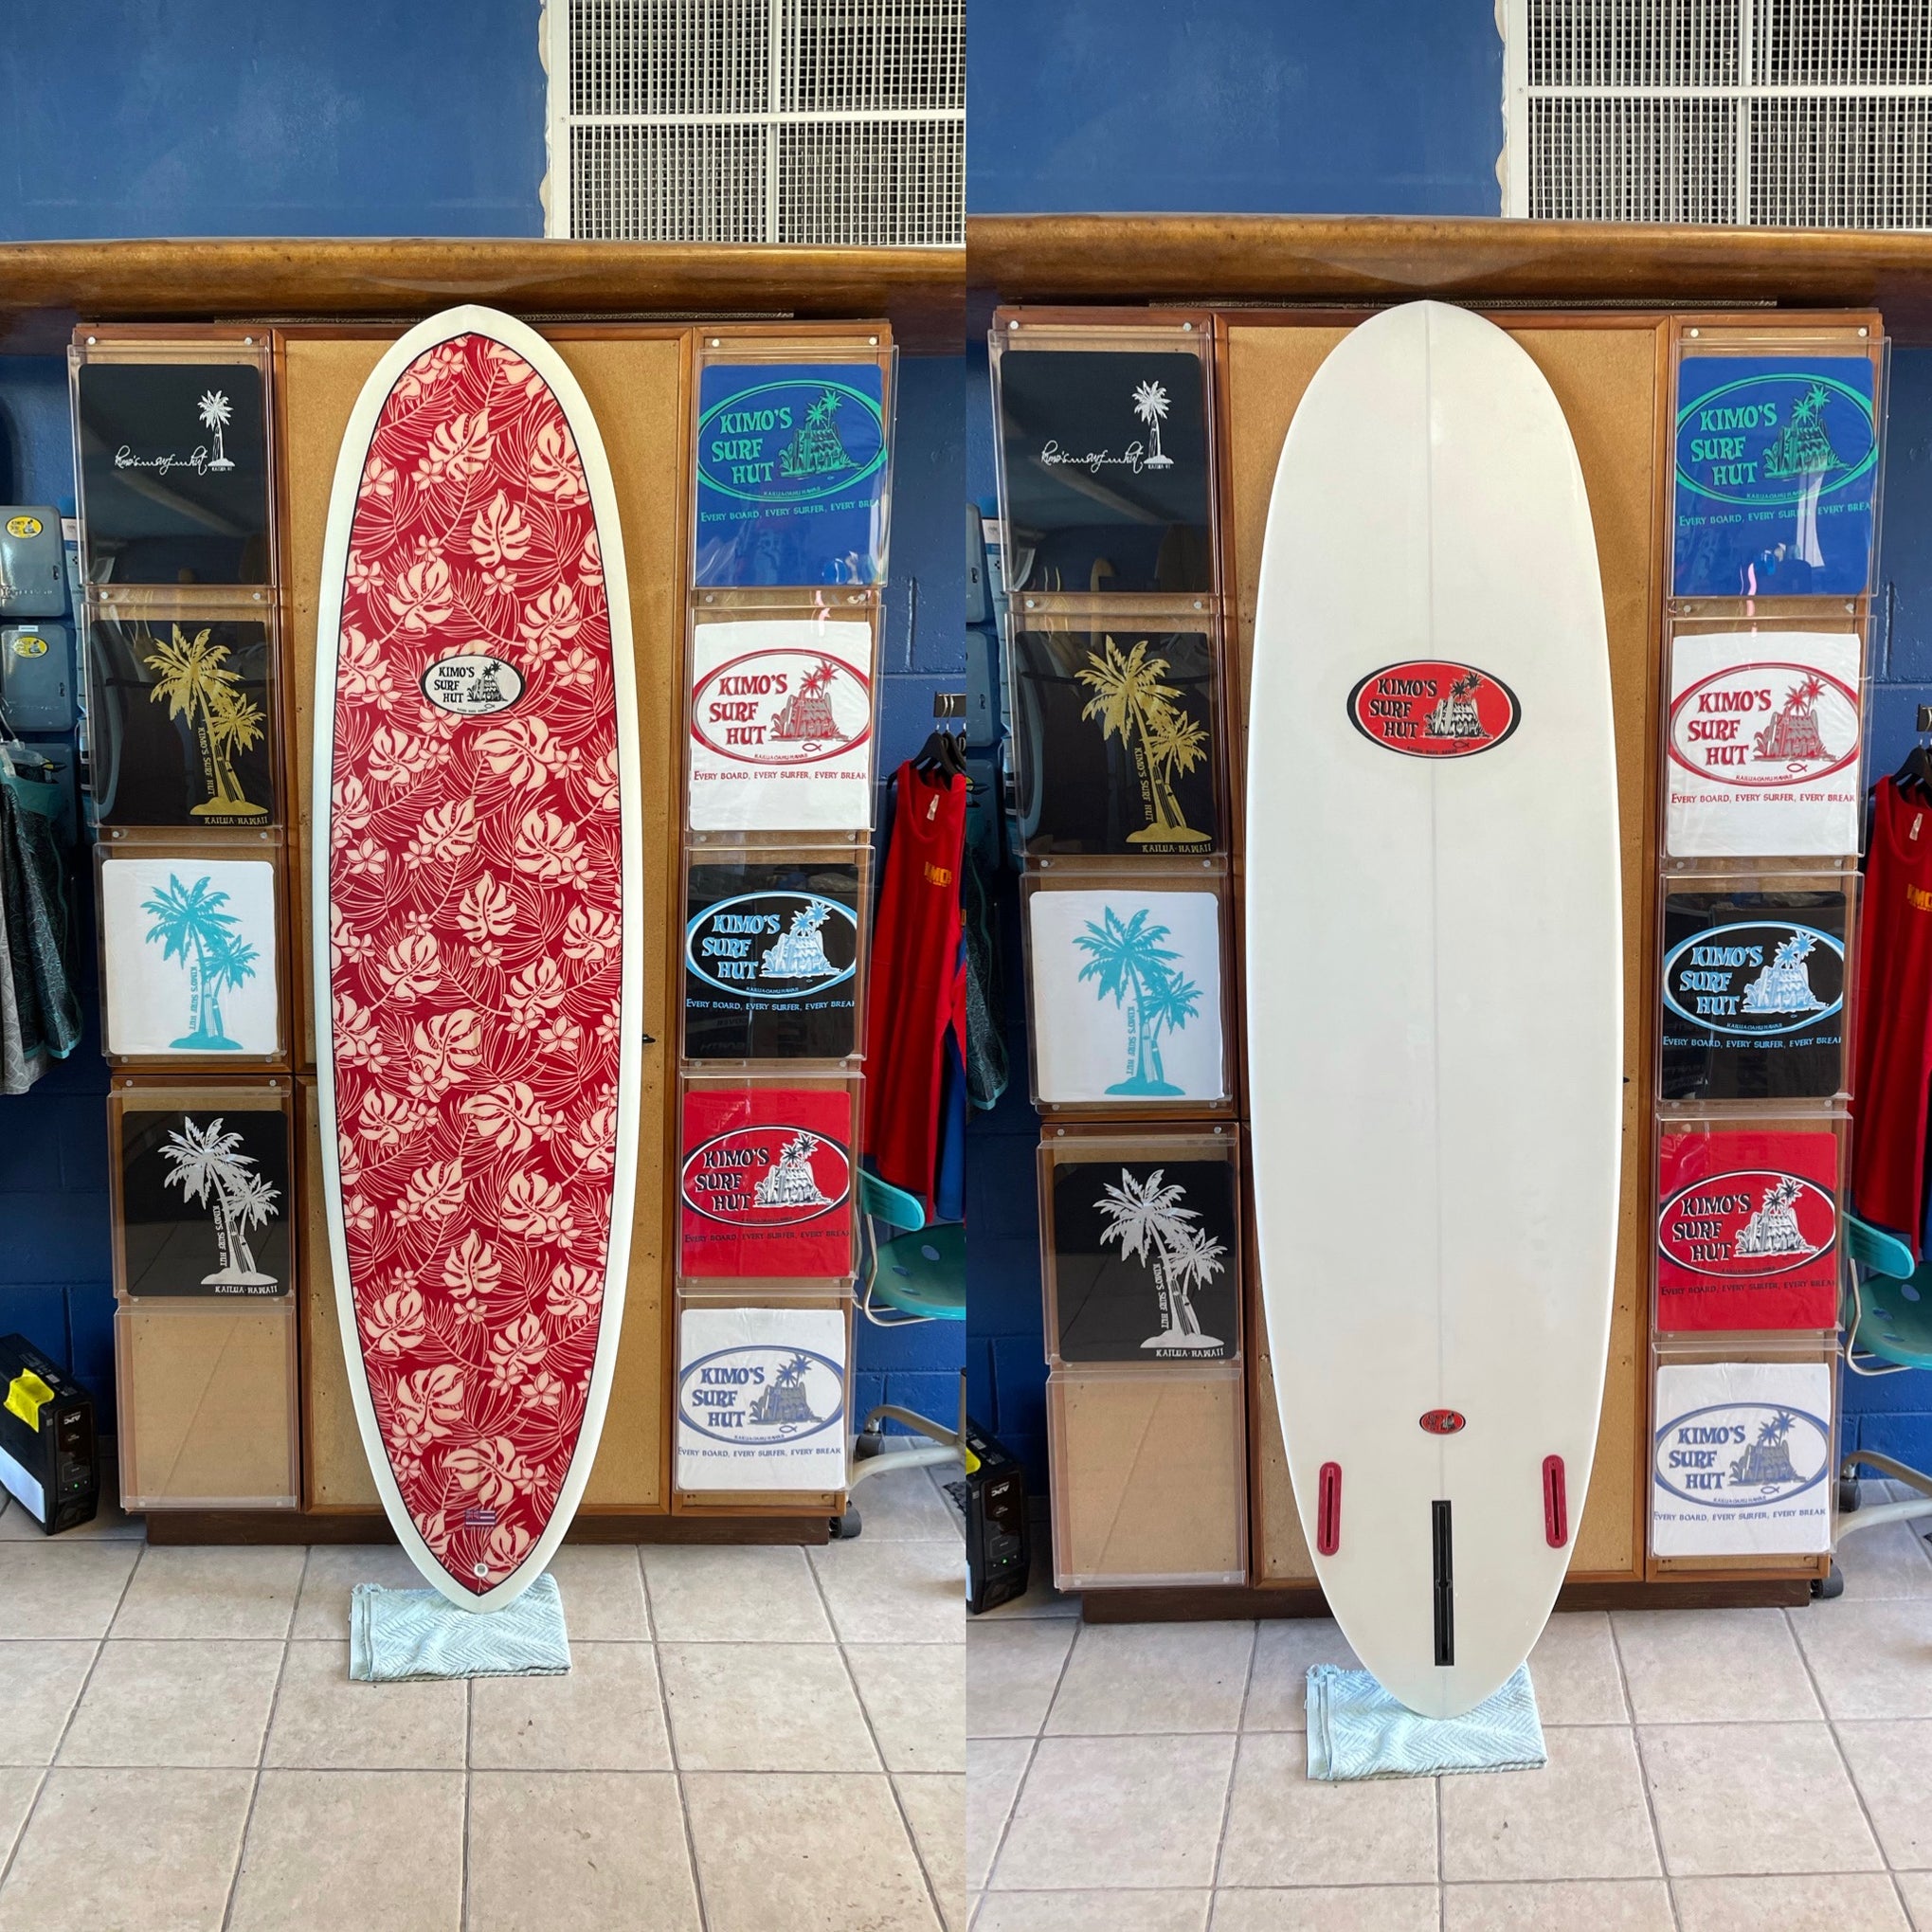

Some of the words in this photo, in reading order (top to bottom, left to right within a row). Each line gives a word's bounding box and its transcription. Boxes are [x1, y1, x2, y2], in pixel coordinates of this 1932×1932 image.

[719, 406, 793, 434] KIMO'S
[1699, 403, 1778, 432] KIMO'S
[712, 438, 764, 462] SURF
[1689, 436, 1746, 463] SURF
[731, 460, 774, 485] HUT
[1711, 461, 1758, 487] HUT
[439, 666, 475, 677] KIMO'S
[434, 679, 460, 691] SURF
[718, 674, 788, 696] KIMO'S
[1377, 678, 1437, 698] KIMO'S
[442, 693, 464, 703] HUT
[1368, 698, 1413, 718] SURF
[1698, 689, 1772, 713] KIMO'S
[709, 701, 759, 724] SURF
[726, 726, 767, 745] HUT
[1382, 721, 1418, 739] HUT
[1688, 719, 1741, 742] SURF
[1705, 745, 1749, 766] HUT
[694, 770, 717, 781] EVERY
[840, 771, 866, 780] BREAK
[207, 780, 215, 796] HUT
[1671, 792, 1697, 803] EVERY
[1735, 793, 1760, 802] EVERY
[1800, 793, 1825, 802] EVERY
[1828, 793, 1855, 802] BREAK
[1145, 804, 1154, 822] HUT
[712, 914, 781, 934] KIMO'S
[701, 937, 751, 957] SURF
[1690, 946, 1763, 967] KIMO'S
[717, 961, 758, 980] HUT
[1679, 970, 1733, 993] SURF
[686, 999, 710, 1008] EVERY
[746, 1002, 768, 1011] EVERY
[805, 1002, 828, 1010] EVERY
[1696, 996, 1741, 1016] HUT
[1663, 1036, 1688, 1046] EVERY
[1790, 1038, 1814, 1047] EVERY
[703, 1147, 769, 1169] KIMO'S
[695, 1173, 743, 1193] SURF
[712, 1194, 752, 1212] HUT
[1681, 1194, 1752, 1217] KIMO'S
[1671, 1220, 1723, 1242] SURF
[1690, 1243, 1732, 1262] HUT
[1161, 1313, 1169, 1329] HUT
[700, 1366, 766, 1385] KIMO'S
[692, 1389, 738, 1408] SURF
[707, 1411, 746, 1428] HUT
[1678, 1425, 1745, 1445] KIMO'S
[1669, 1450, 1718, 1469] SURF
[1686, 1472, 1724, 1490] HUT
